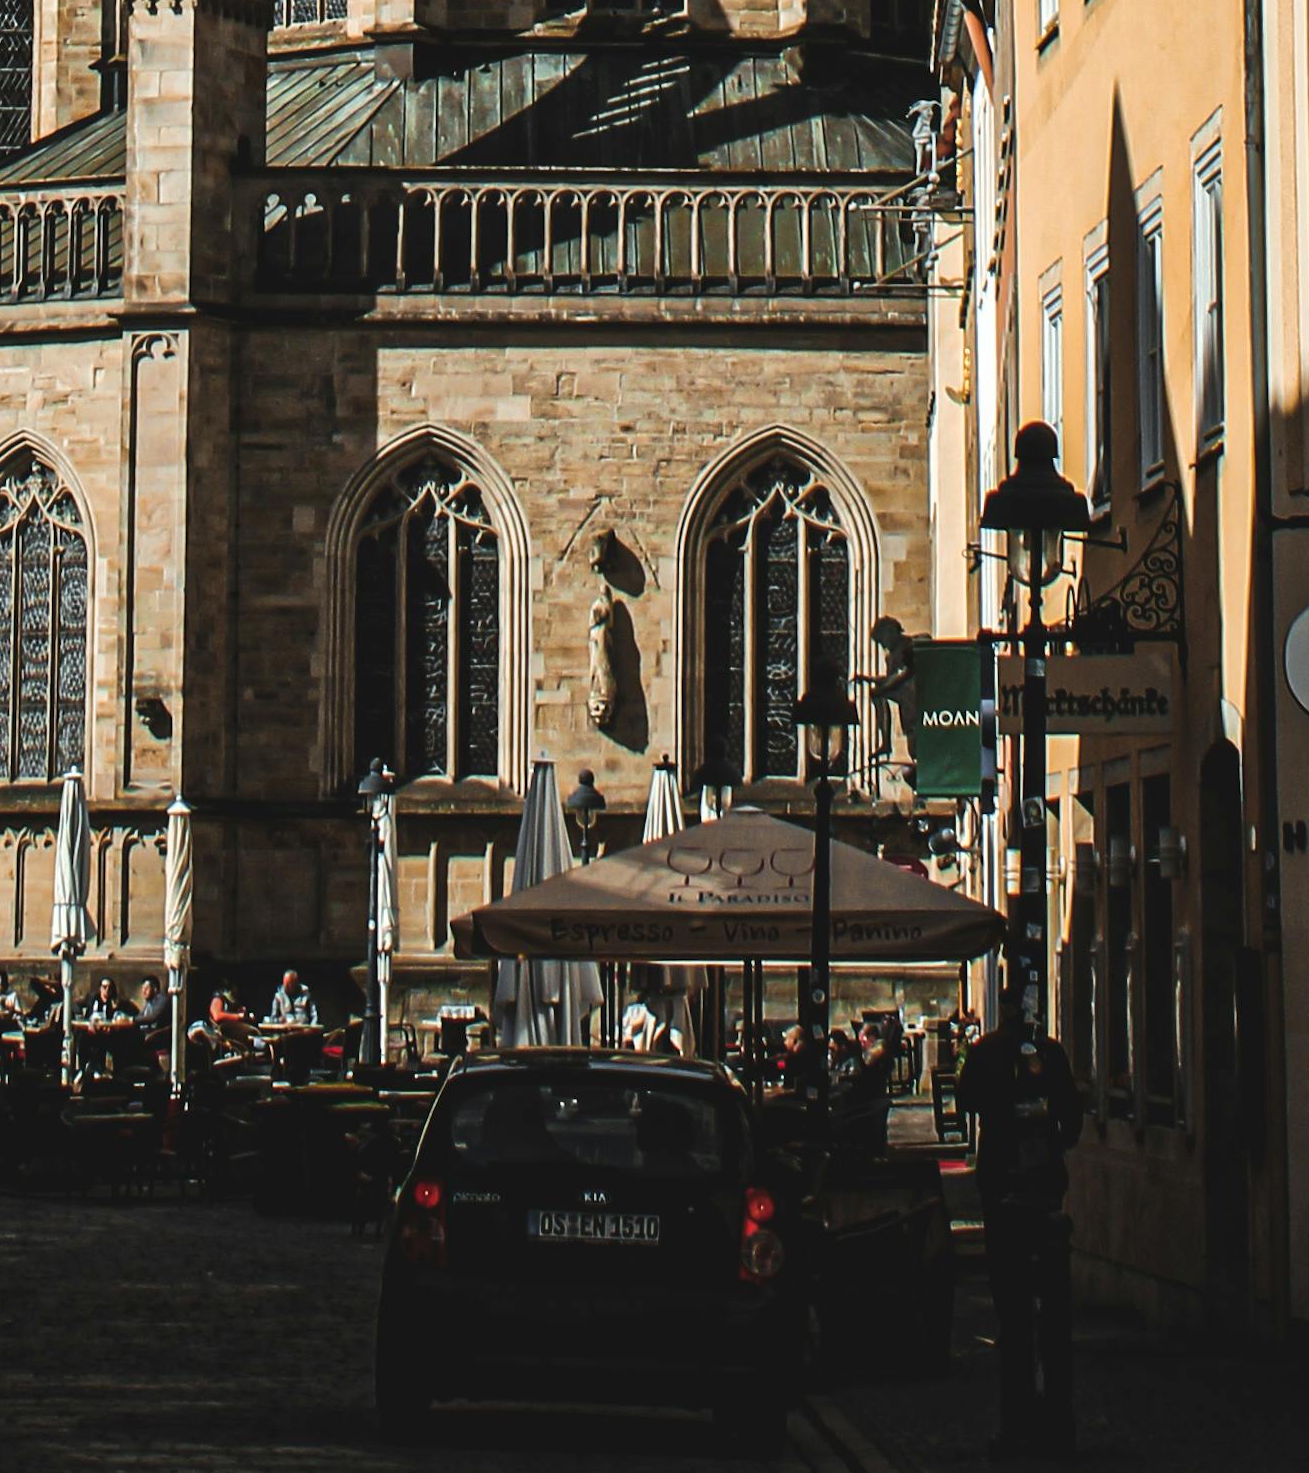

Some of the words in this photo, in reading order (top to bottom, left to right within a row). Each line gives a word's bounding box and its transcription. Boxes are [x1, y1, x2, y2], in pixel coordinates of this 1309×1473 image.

[550, 917, 675, 949] Espresso
[722, 921, 781, 942] Vino
[831, 917, 924, 943] Panino
[583, 1191, 608, 1205] KIA
